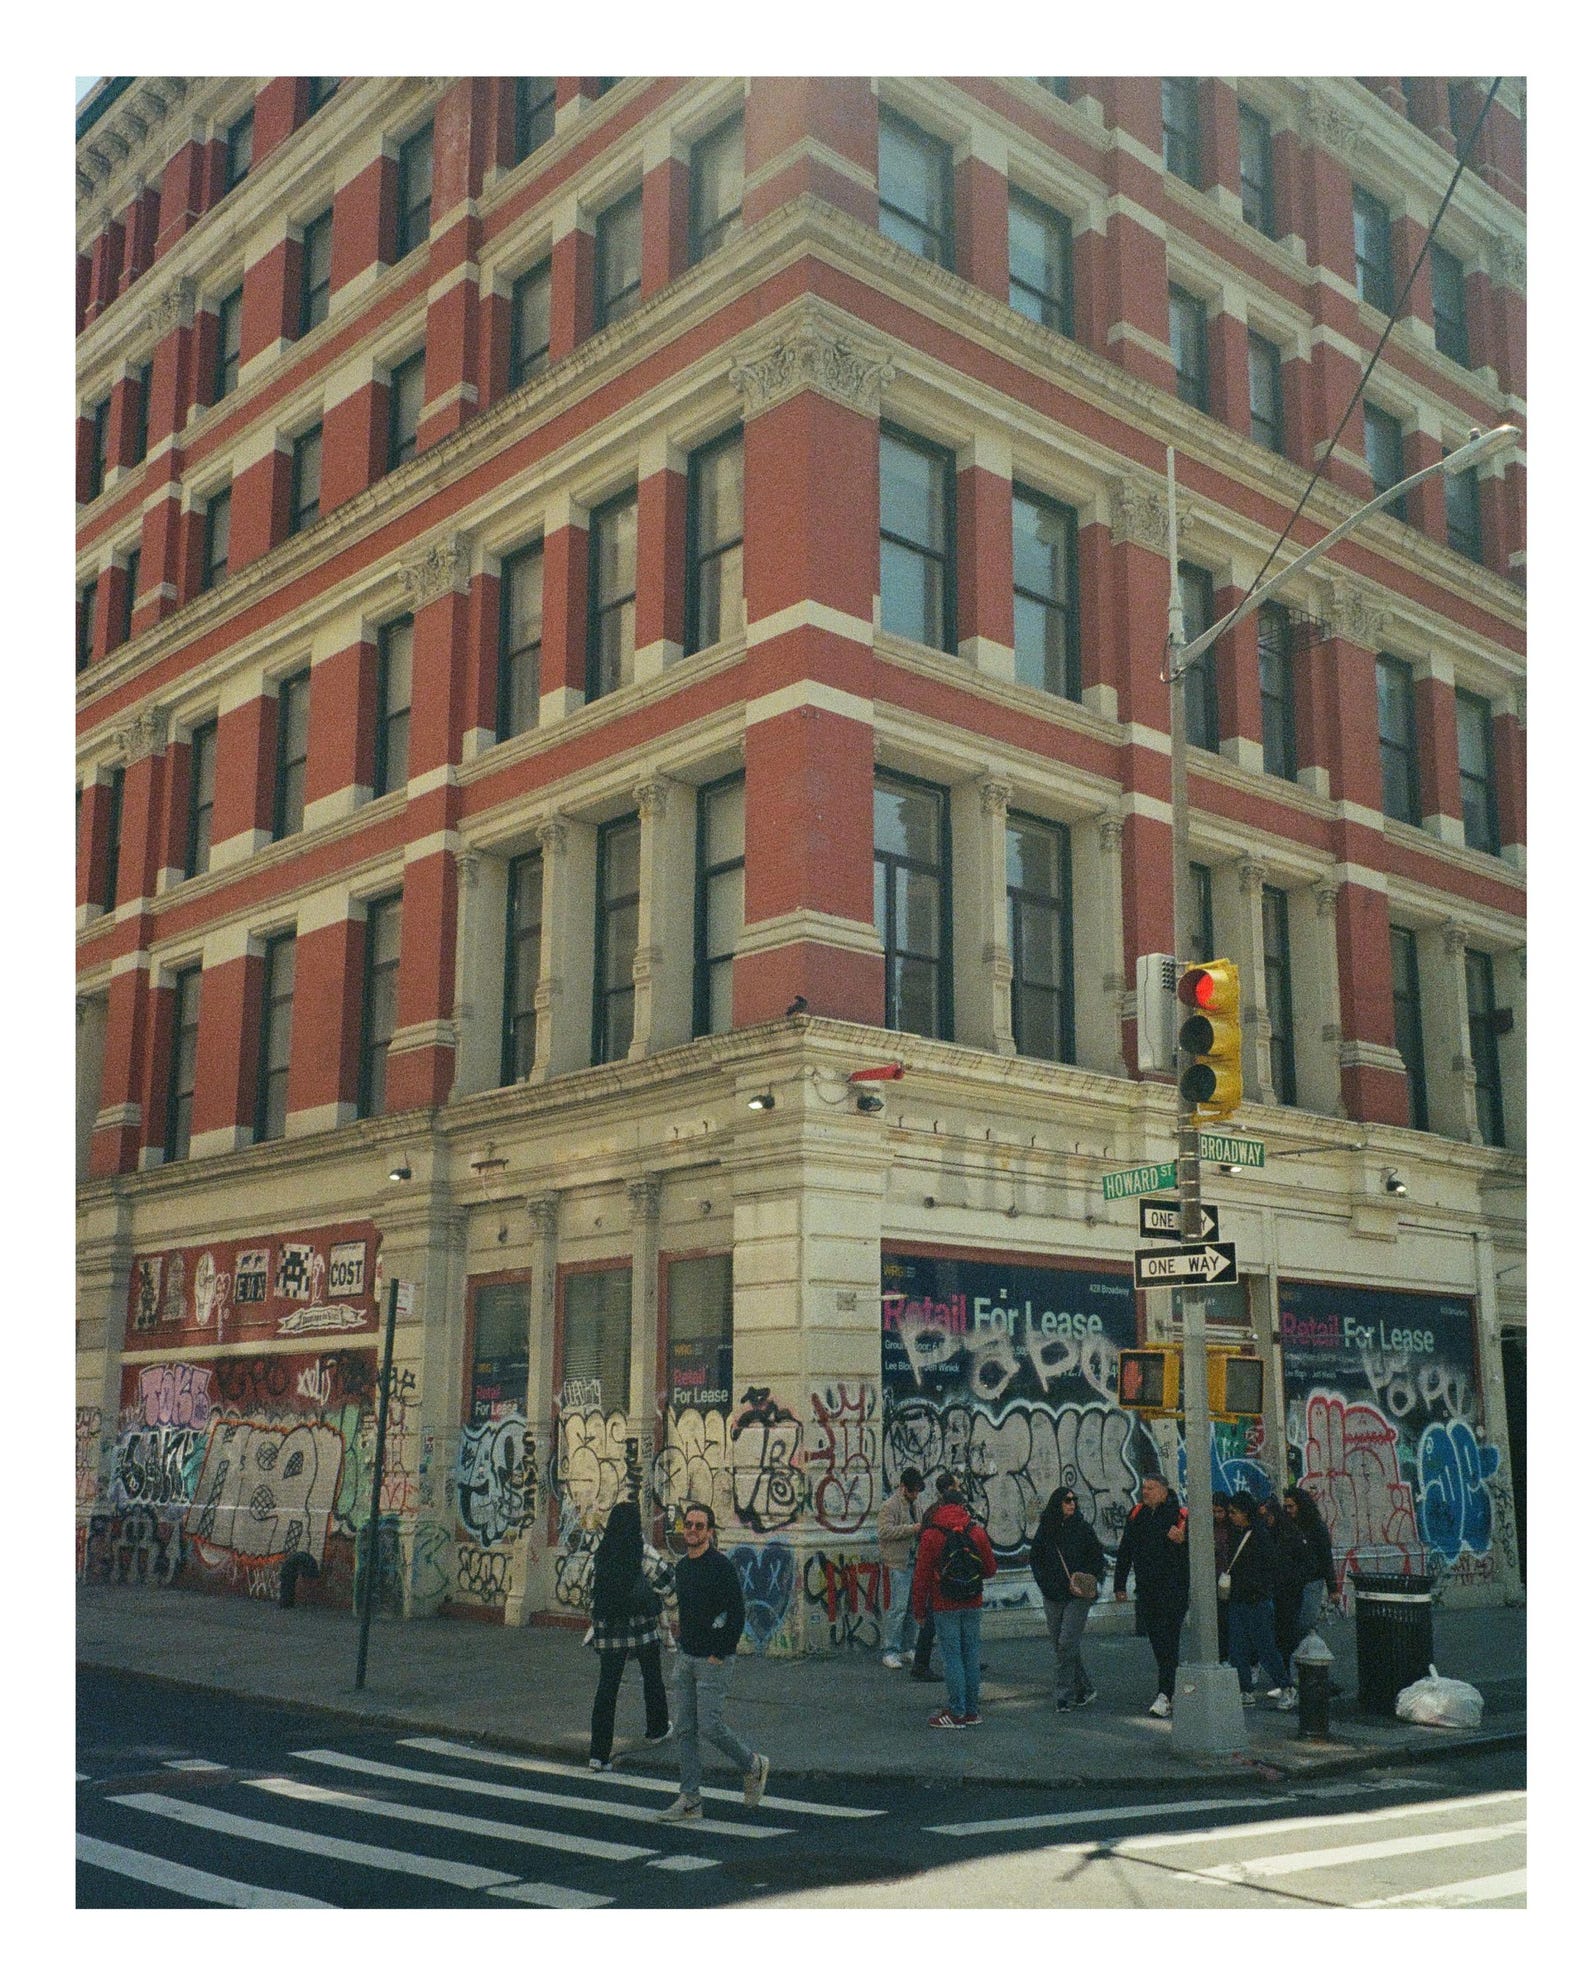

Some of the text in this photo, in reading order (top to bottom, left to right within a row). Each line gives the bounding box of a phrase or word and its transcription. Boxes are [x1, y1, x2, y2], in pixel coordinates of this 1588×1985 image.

[1201, 1136, 1262, 1166] BROADWAY
[1107, 1164, 1173, 1199] HOWARD ST
[1151, 1210, 1174, 1228] ONE
[331, 1261, 363, 1287] COST
[1149, 1256, 1219, 1274] ONE WAY
[883, 1289, 1103, 1340] Retail For Lease
[1343, 1317, 1374, 1349] For
[1380, 1319, 1435, 1353] Lease
[674, 1386, 728, 1404] For Lease
[475, 1401, 490, 1416] For
